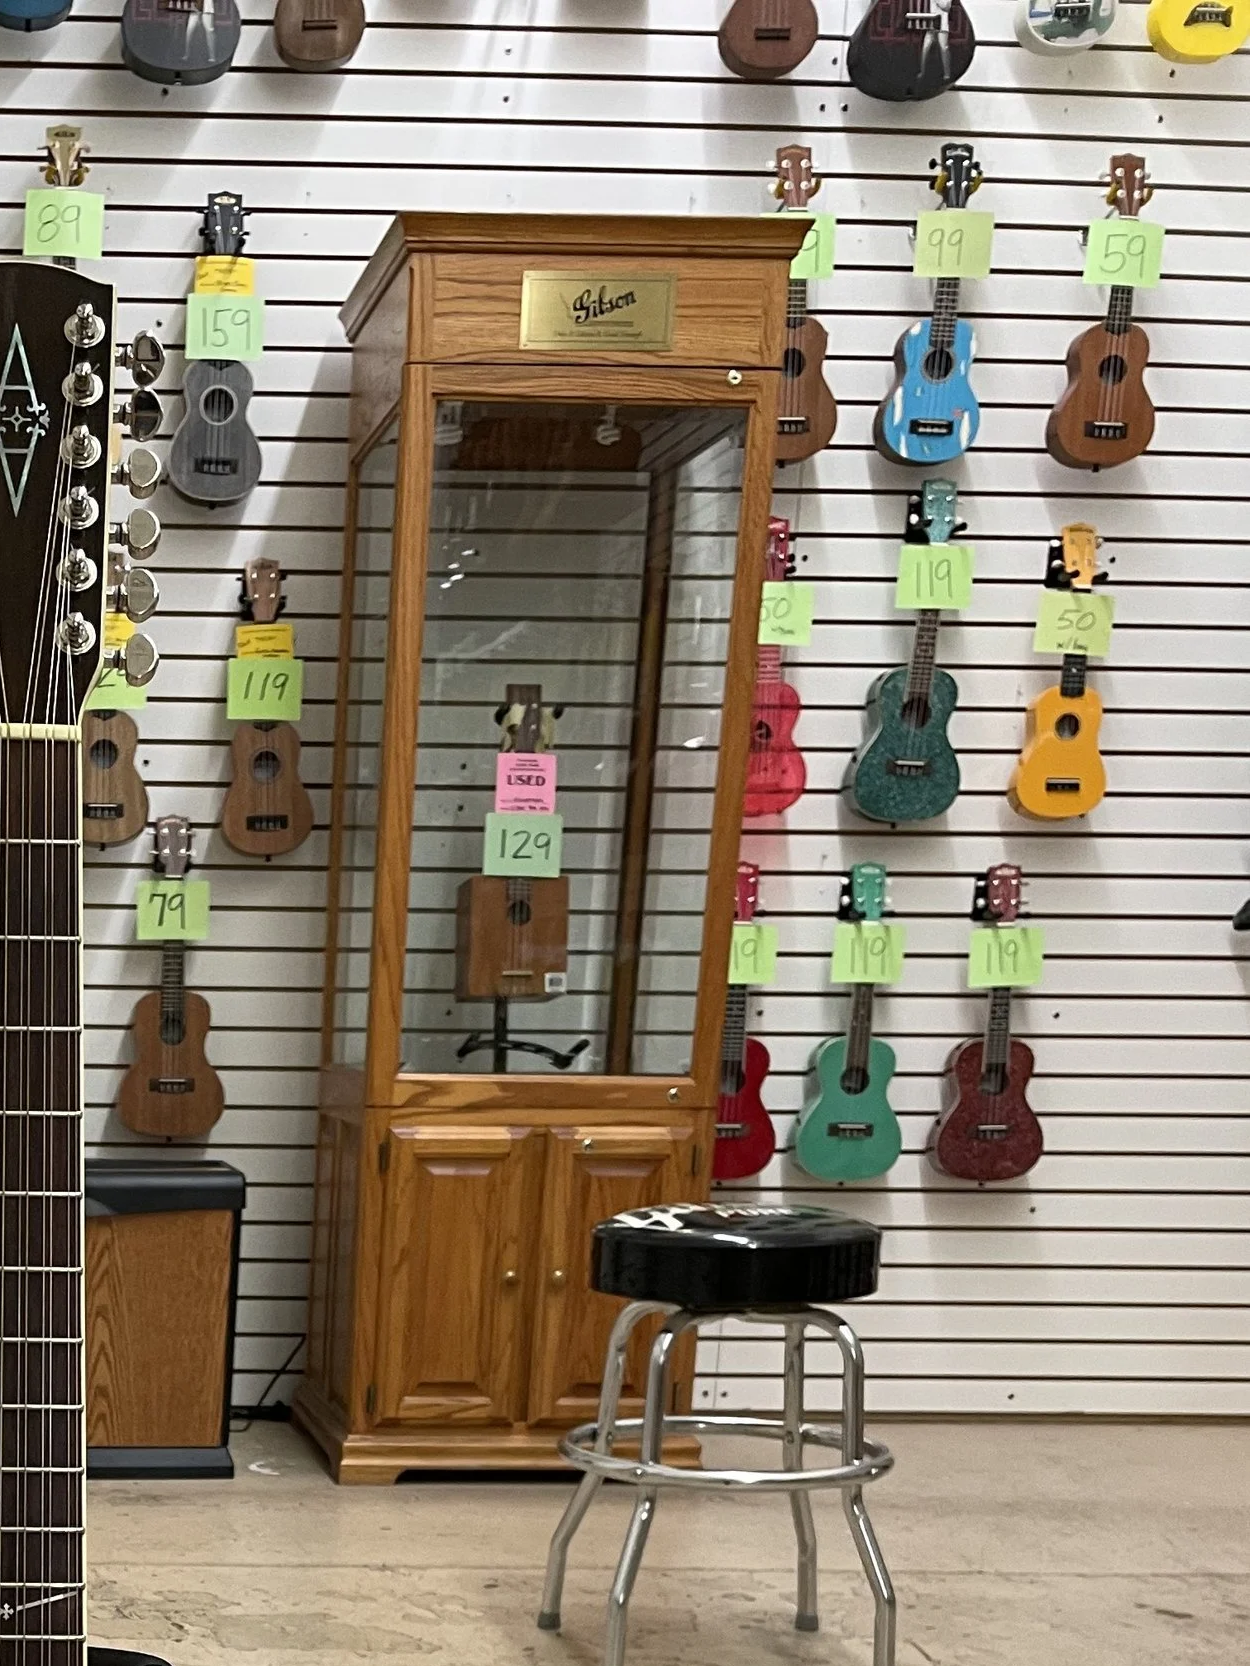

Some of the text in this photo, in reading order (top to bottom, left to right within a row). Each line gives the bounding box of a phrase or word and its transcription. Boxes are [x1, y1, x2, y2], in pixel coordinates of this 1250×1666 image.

[37, 204, 81, 243] 89
[801, 228, 821, 273] 9
[928, 228, 964, 267] 99
[1099, 233, 1147, 279] 59
[572, 285, 637, 324] Gibson
[202, 307, 251, 351] 159
[916, 559, 953, 598] 119
[1057, 608, 1097, 632] 50
[244, 671, 289, 701] 119
[507, 774, 547, 787] USED
[499, 828, 552, 860] 129
[149, 892, 186, 930] 79
[851, 936, 888, 975] 119
[986, 939, 1019, 975] 119
